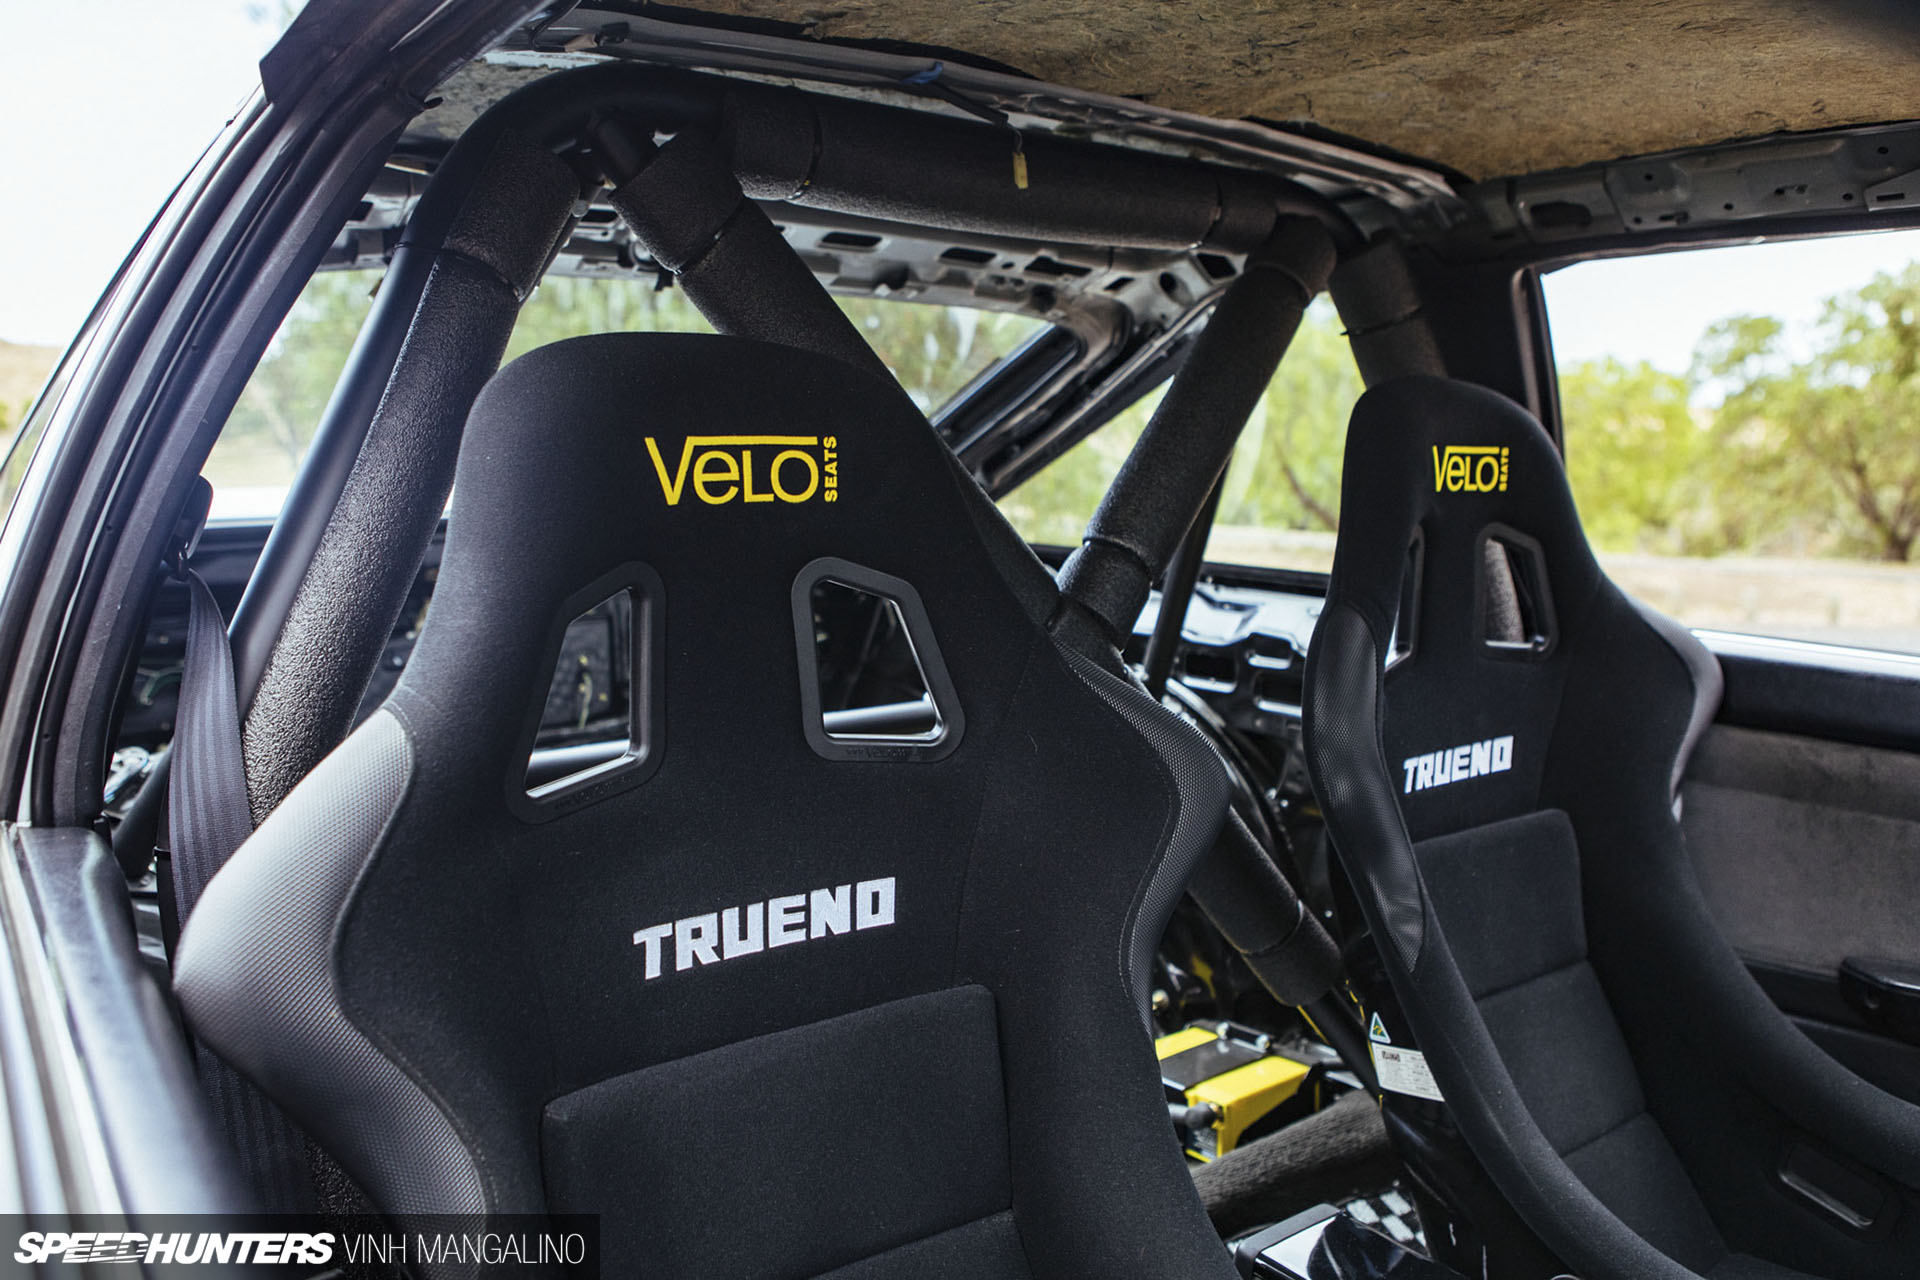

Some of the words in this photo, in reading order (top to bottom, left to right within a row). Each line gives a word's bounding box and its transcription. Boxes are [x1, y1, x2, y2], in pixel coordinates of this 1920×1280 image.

[822, 435, 838, 503] SEATS
[1403, 735, 1514, 794] TRUENO
[632, 876, 896, 980] TRUENO
